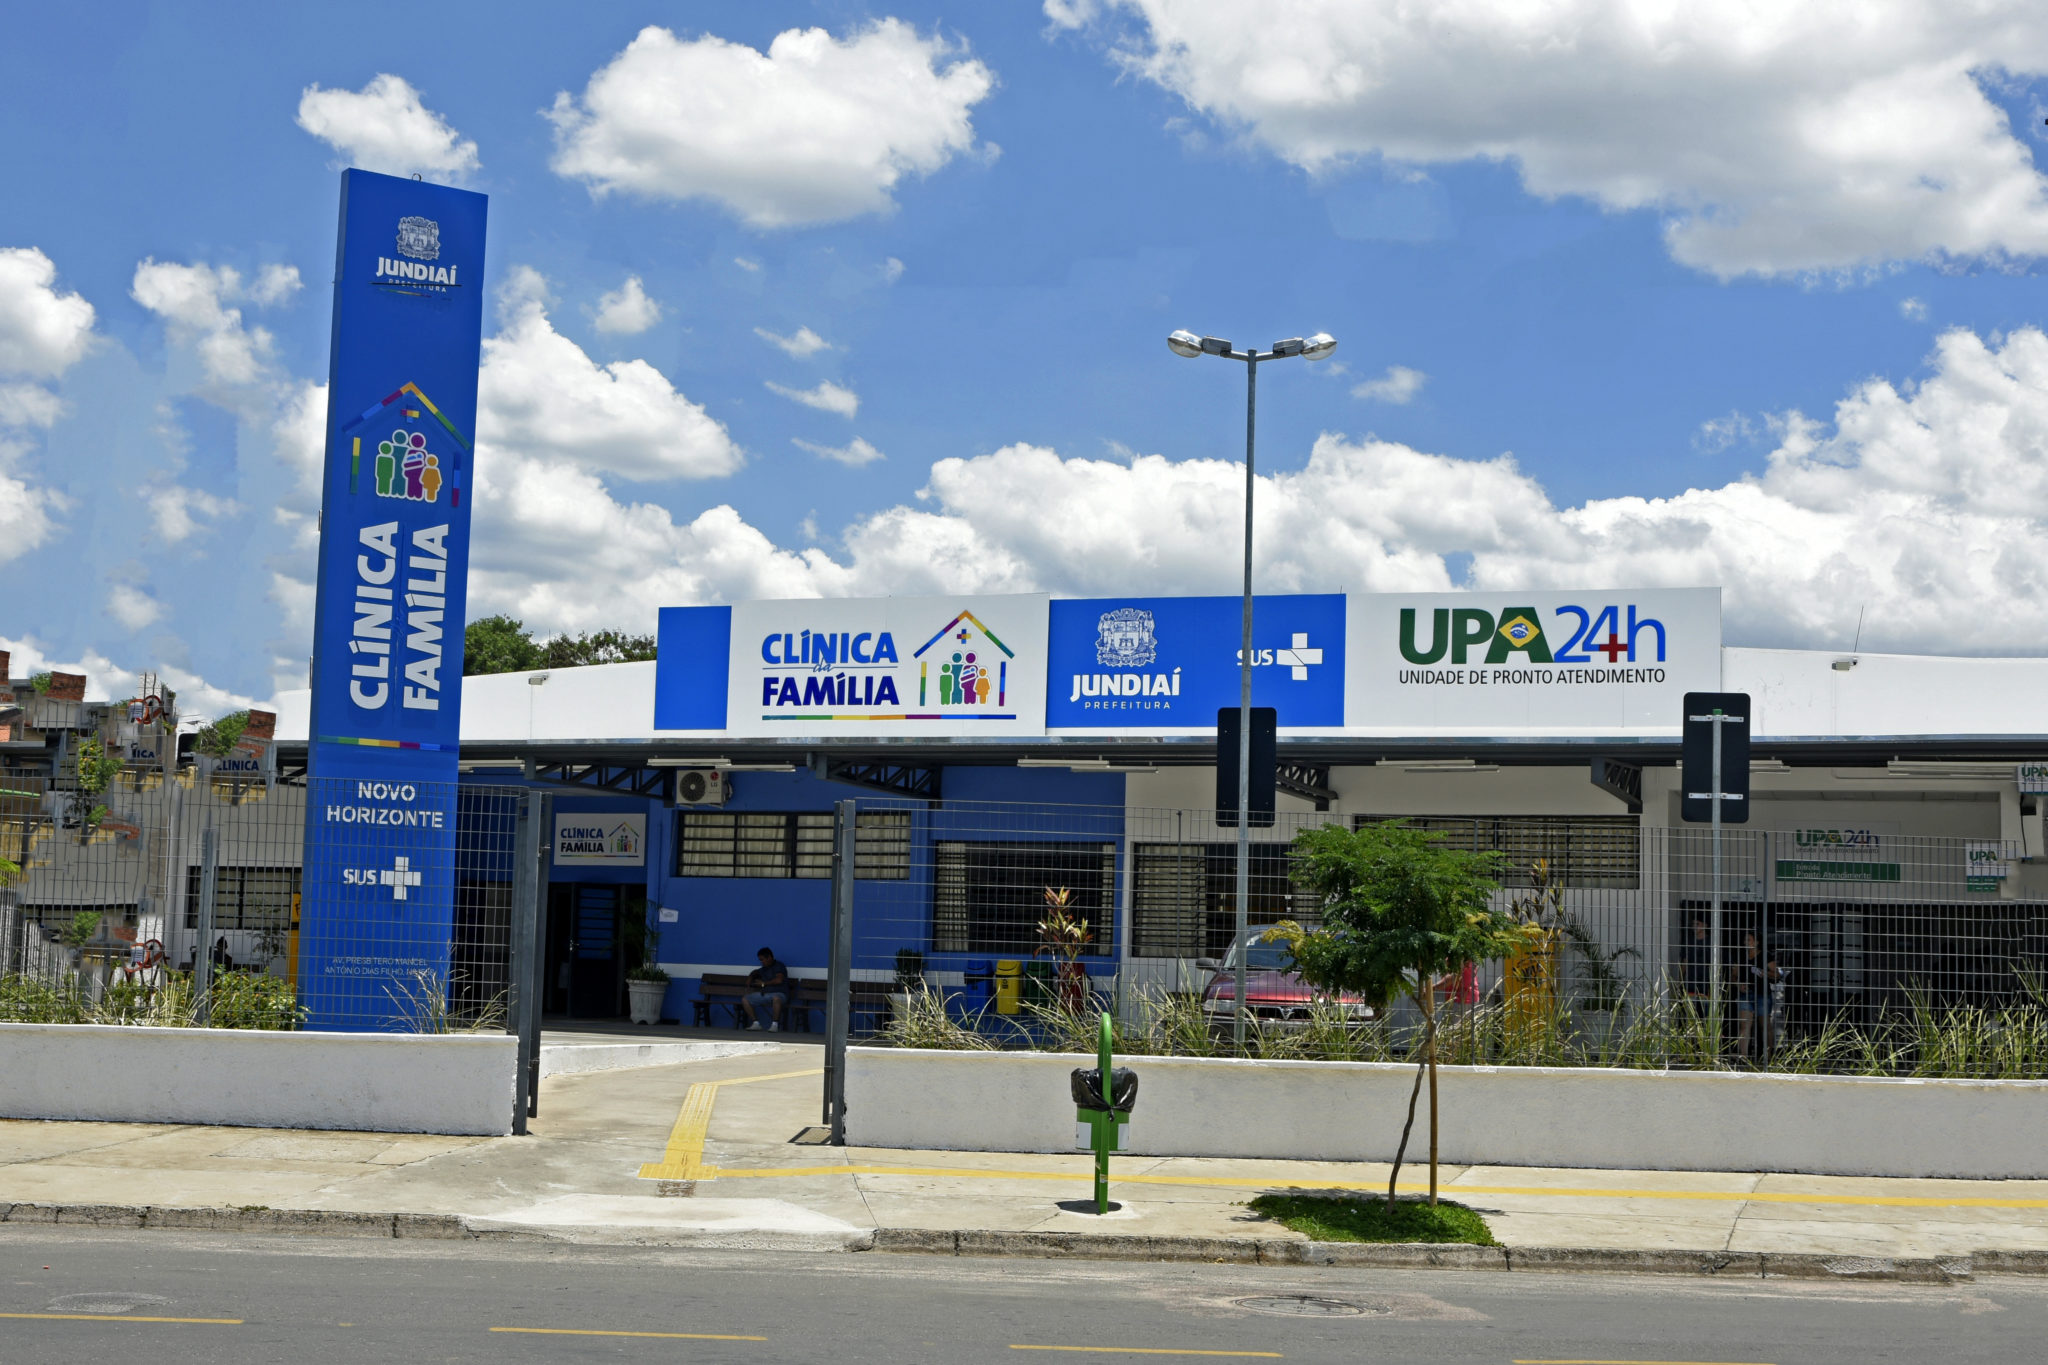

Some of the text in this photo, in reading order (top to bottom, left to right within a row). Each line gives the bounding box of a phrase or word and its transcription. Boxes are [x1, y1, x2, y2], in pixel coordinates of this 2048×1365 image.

[376, 257, 457, 285] JUNDIAÍ
[388, 279, 447, 293] PREFEITURA
[348, 521, 399, 710] CLÍNICA
[403, 523, 449, 711] FAMÍLIA
[761, 629, 899, 664] CLÍNICA
[1069, 666, 1182, 702] JUNDIAÍ
[1399, 668, 1666, 685] UNIDADE DE PRONTO ATENDIMENTO
[762, 672, 900, 706] FAMÍLIA
[1084, 701, 1171, 710] PREFEITURA
[358, 782, 416, 801] NOVO
[327, 805, 444, 828] HORIZONTE
[560, 826, 604, 839] CLÍNICA
[560, 841, 604, 853] FAMÍLIA
[343, 868, 377, 885] SUS
[346, 957, 393, 965] PRESBTERO
[325, 966, 360, 975] ANTÔNO
